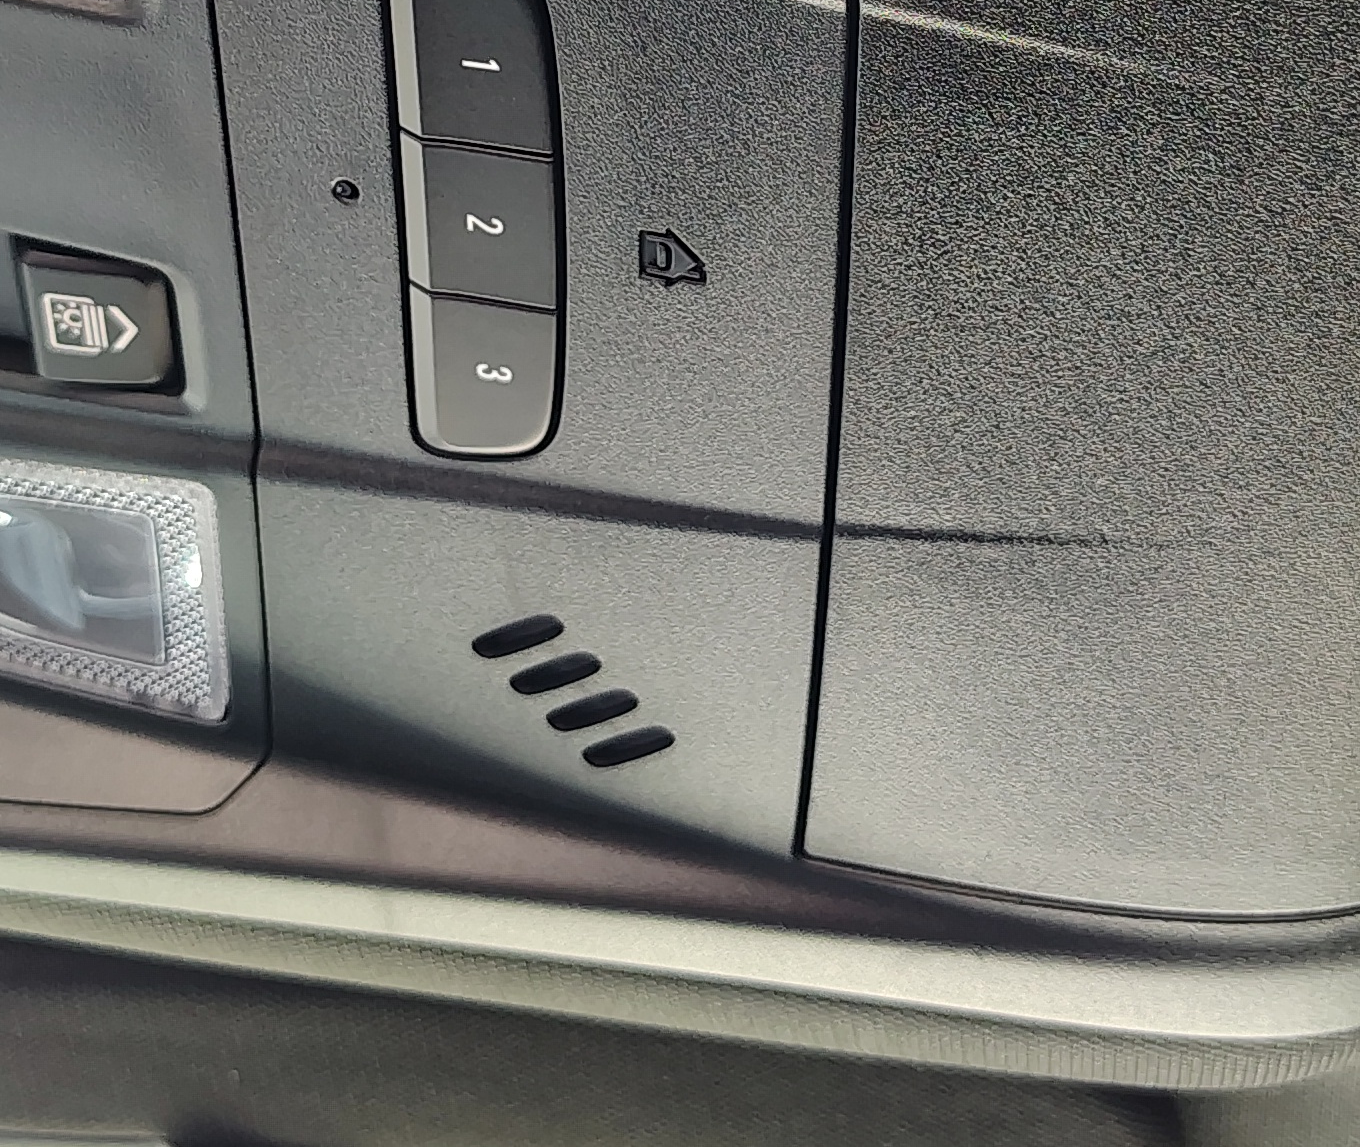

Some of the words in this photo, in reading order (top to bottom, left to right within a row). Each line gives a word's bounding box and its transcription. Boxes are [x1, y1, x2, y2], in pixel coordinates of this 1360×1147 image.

[460, 58, 500, 73] 1
[466, 212, 504, 236] 2
[475, 362, 513, 384] 3
